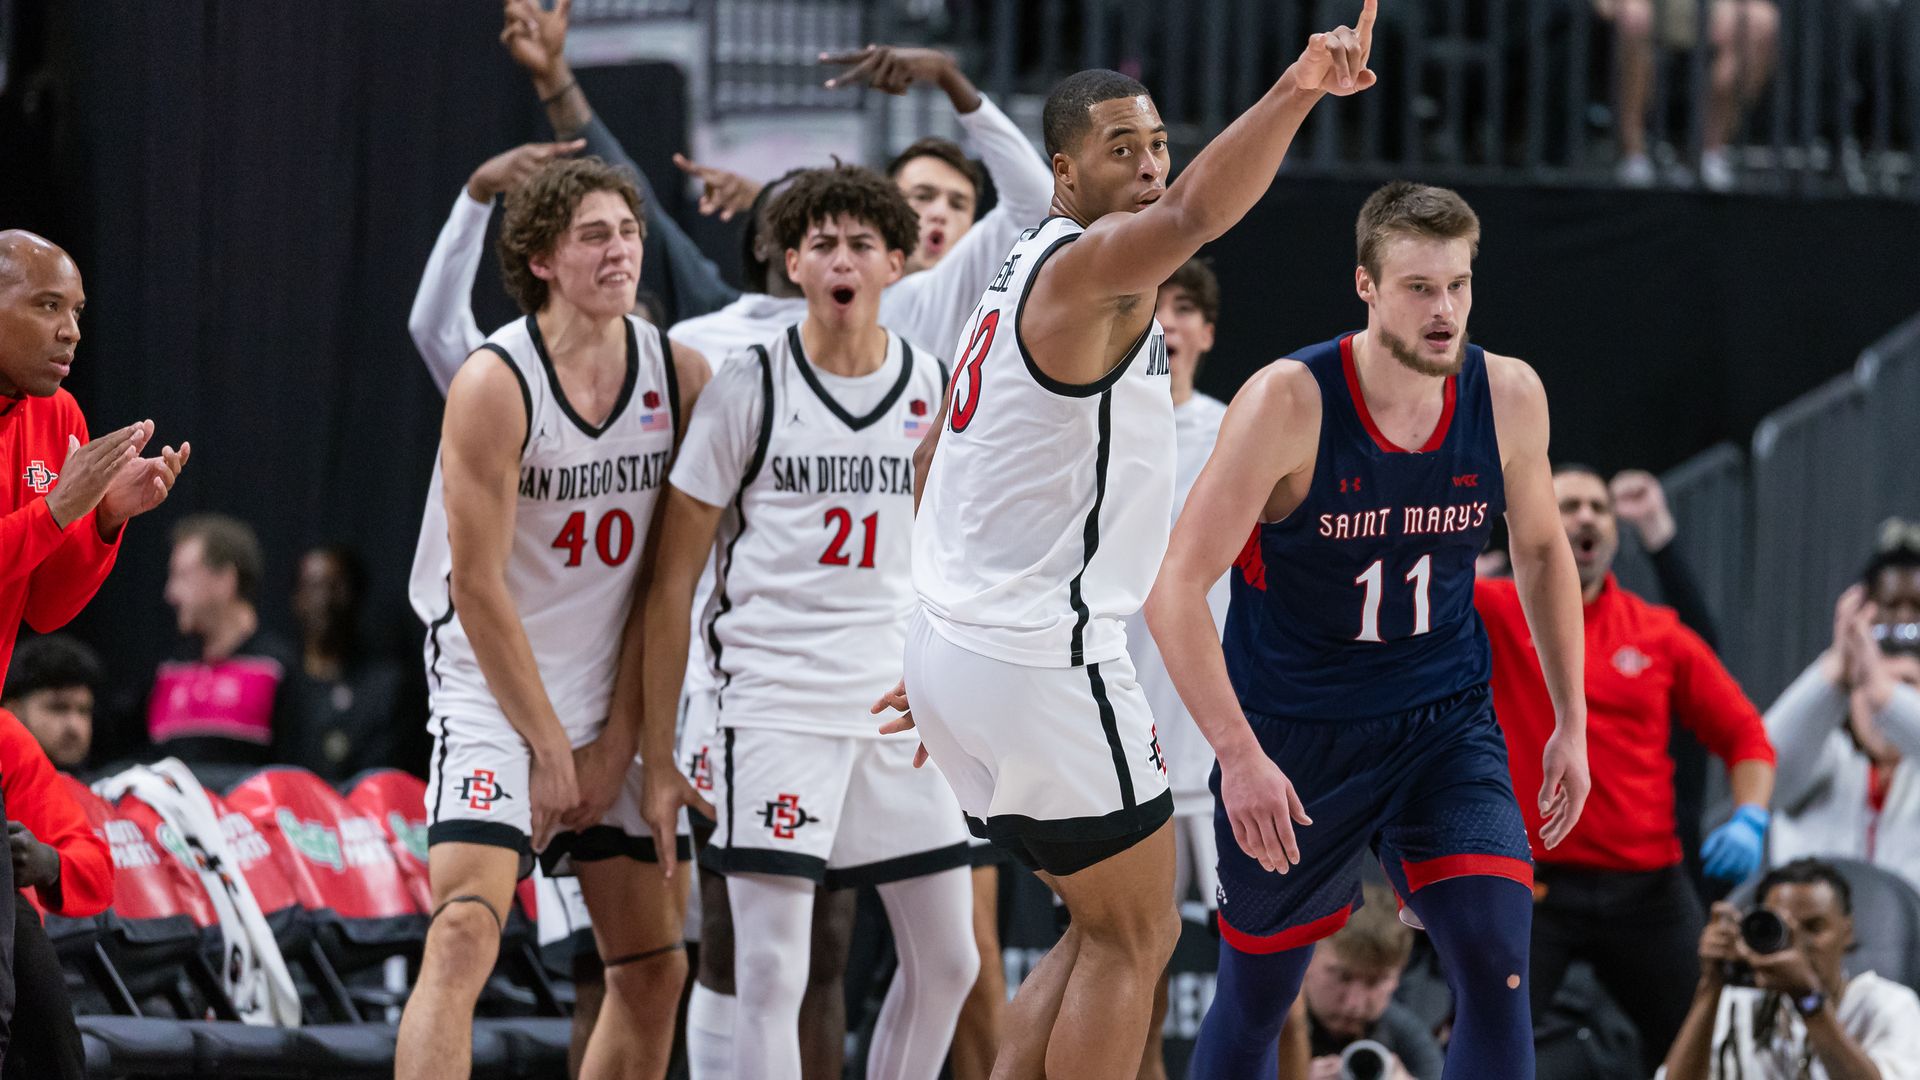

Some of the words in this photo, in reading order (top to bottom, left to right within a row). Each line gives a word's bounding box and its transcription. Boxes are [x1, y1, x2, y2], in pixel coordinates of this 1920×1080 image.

[557, 459, 613, 500] DIEGO
[772, 455, 811, 494] SAN
[817, 455, 873, 493] DIEGO
[551, 508, 634, 568] 40
[818, 507, 879, 569] 21
[1319, 507, 1392, 539] SAINT
[1403, 501, 1488, 535] MARY'S
[1354, 554, 1431, 643] 11
